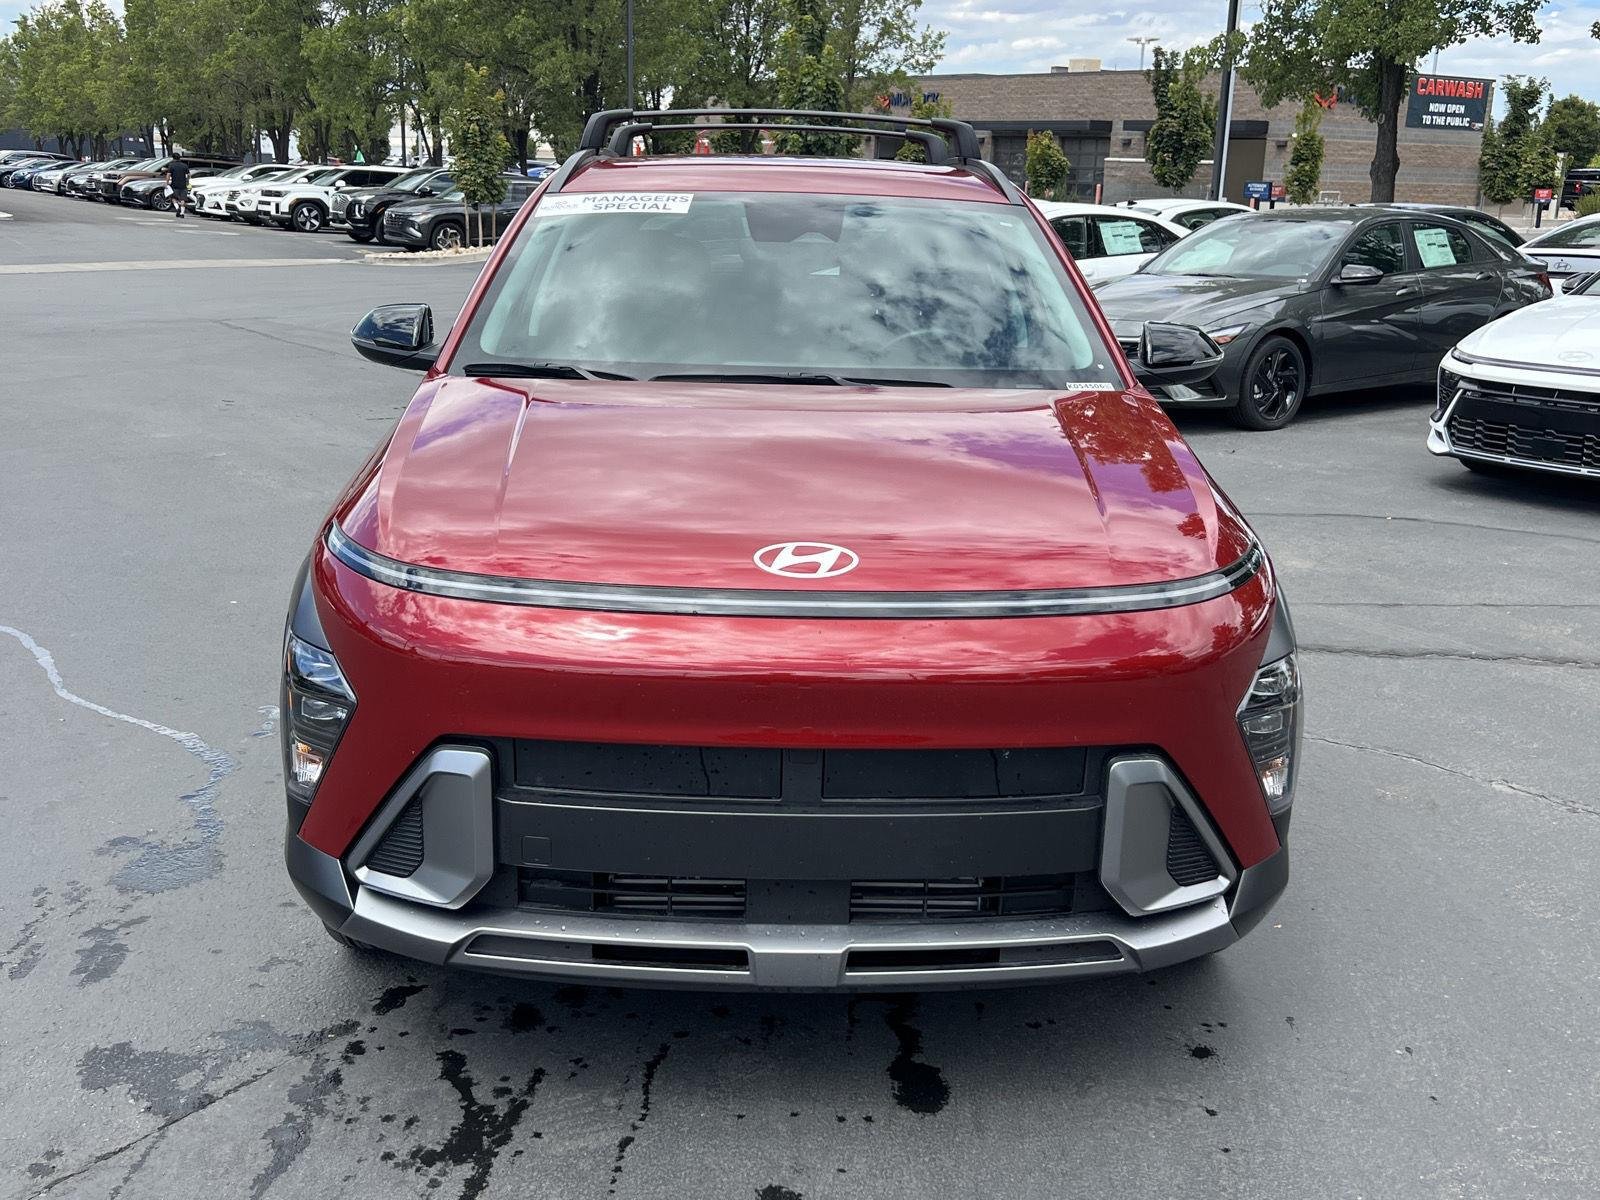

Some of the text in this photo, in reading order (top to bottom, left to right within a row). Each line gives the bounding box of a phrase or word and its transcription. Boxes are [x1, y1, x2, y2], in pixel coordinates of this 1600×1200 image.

[1417, 78, 1484, 98] CARWASH
[1429, 103, 1465, 114] NOW OPEN
[1422, 115, 1431, 124] TO
[1432, 115, 1445, 125] THE
[1446, 116, 1470, 127] PUBLIC
[583, 195, 690, 203] MANAGERS
